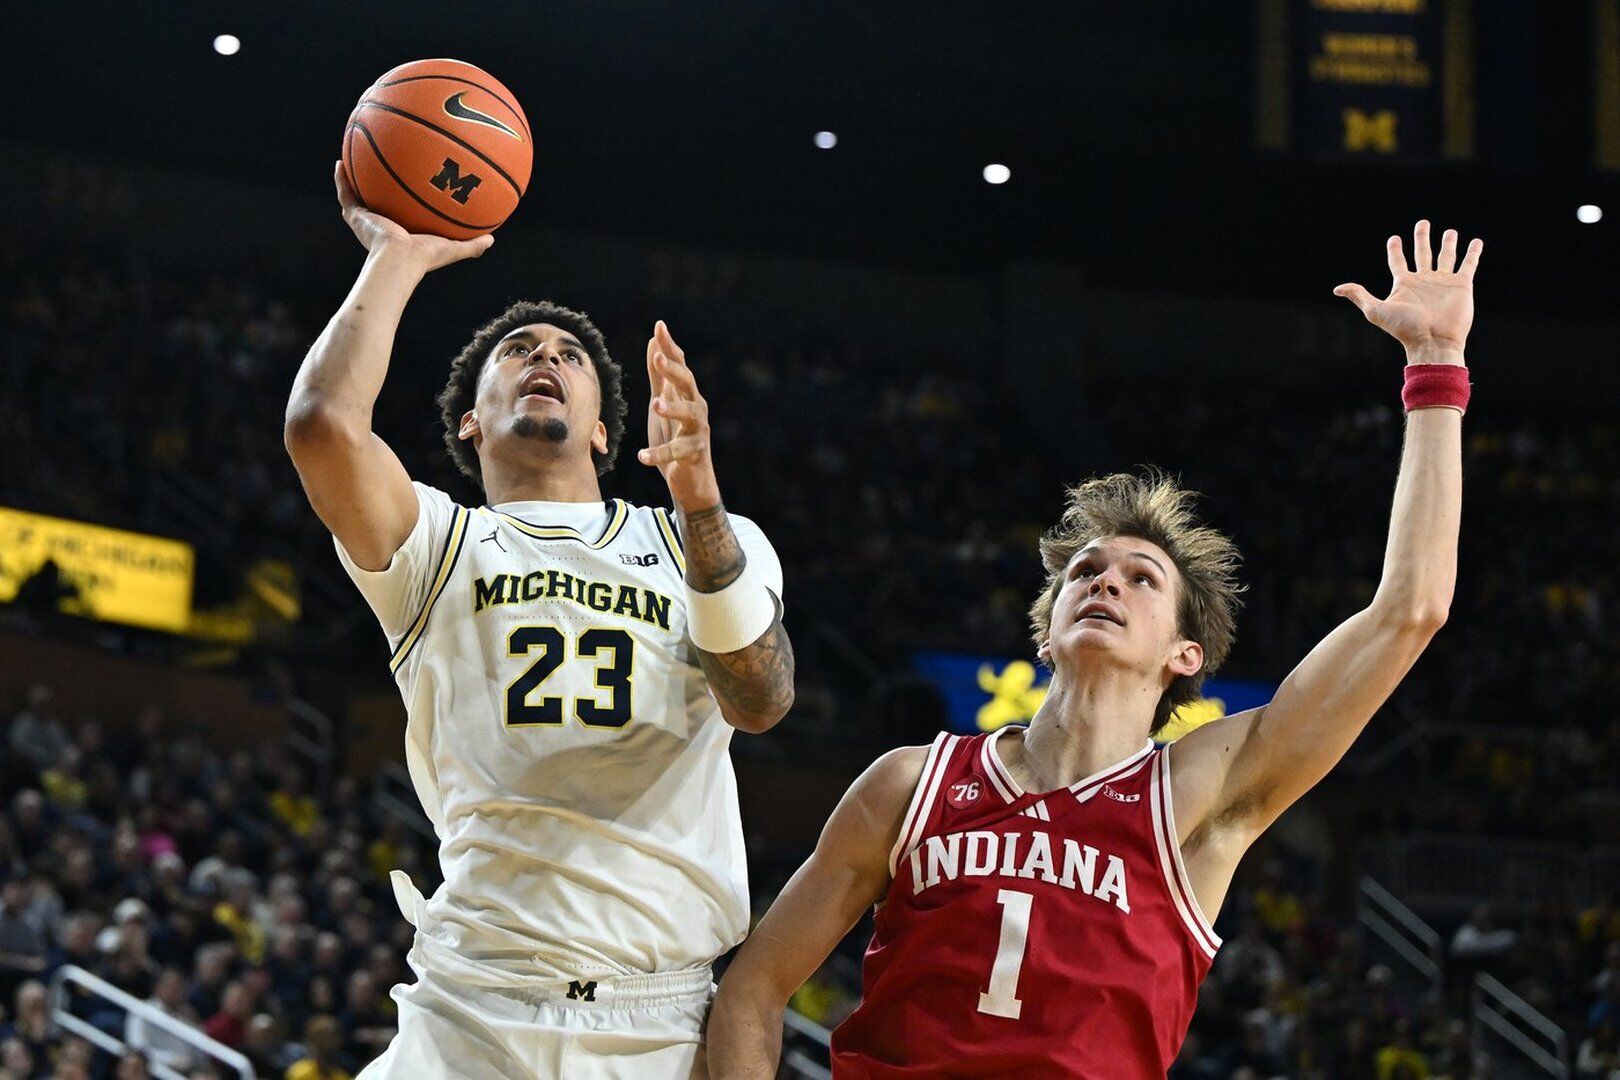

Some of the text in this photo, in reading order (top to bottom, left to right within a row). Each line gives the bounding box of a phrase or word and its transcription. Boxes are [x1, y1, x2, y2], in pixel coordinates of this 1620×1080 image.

[429, 157, 482, 206] M
[473, 569, 672, 632] MICHIGAN
[504, 624, 636, 730] 23
[909, 830, 1131, 915] INDIANA
[566, 980, 598, 1002] M
[976, 888, 1034, 1020] 1
